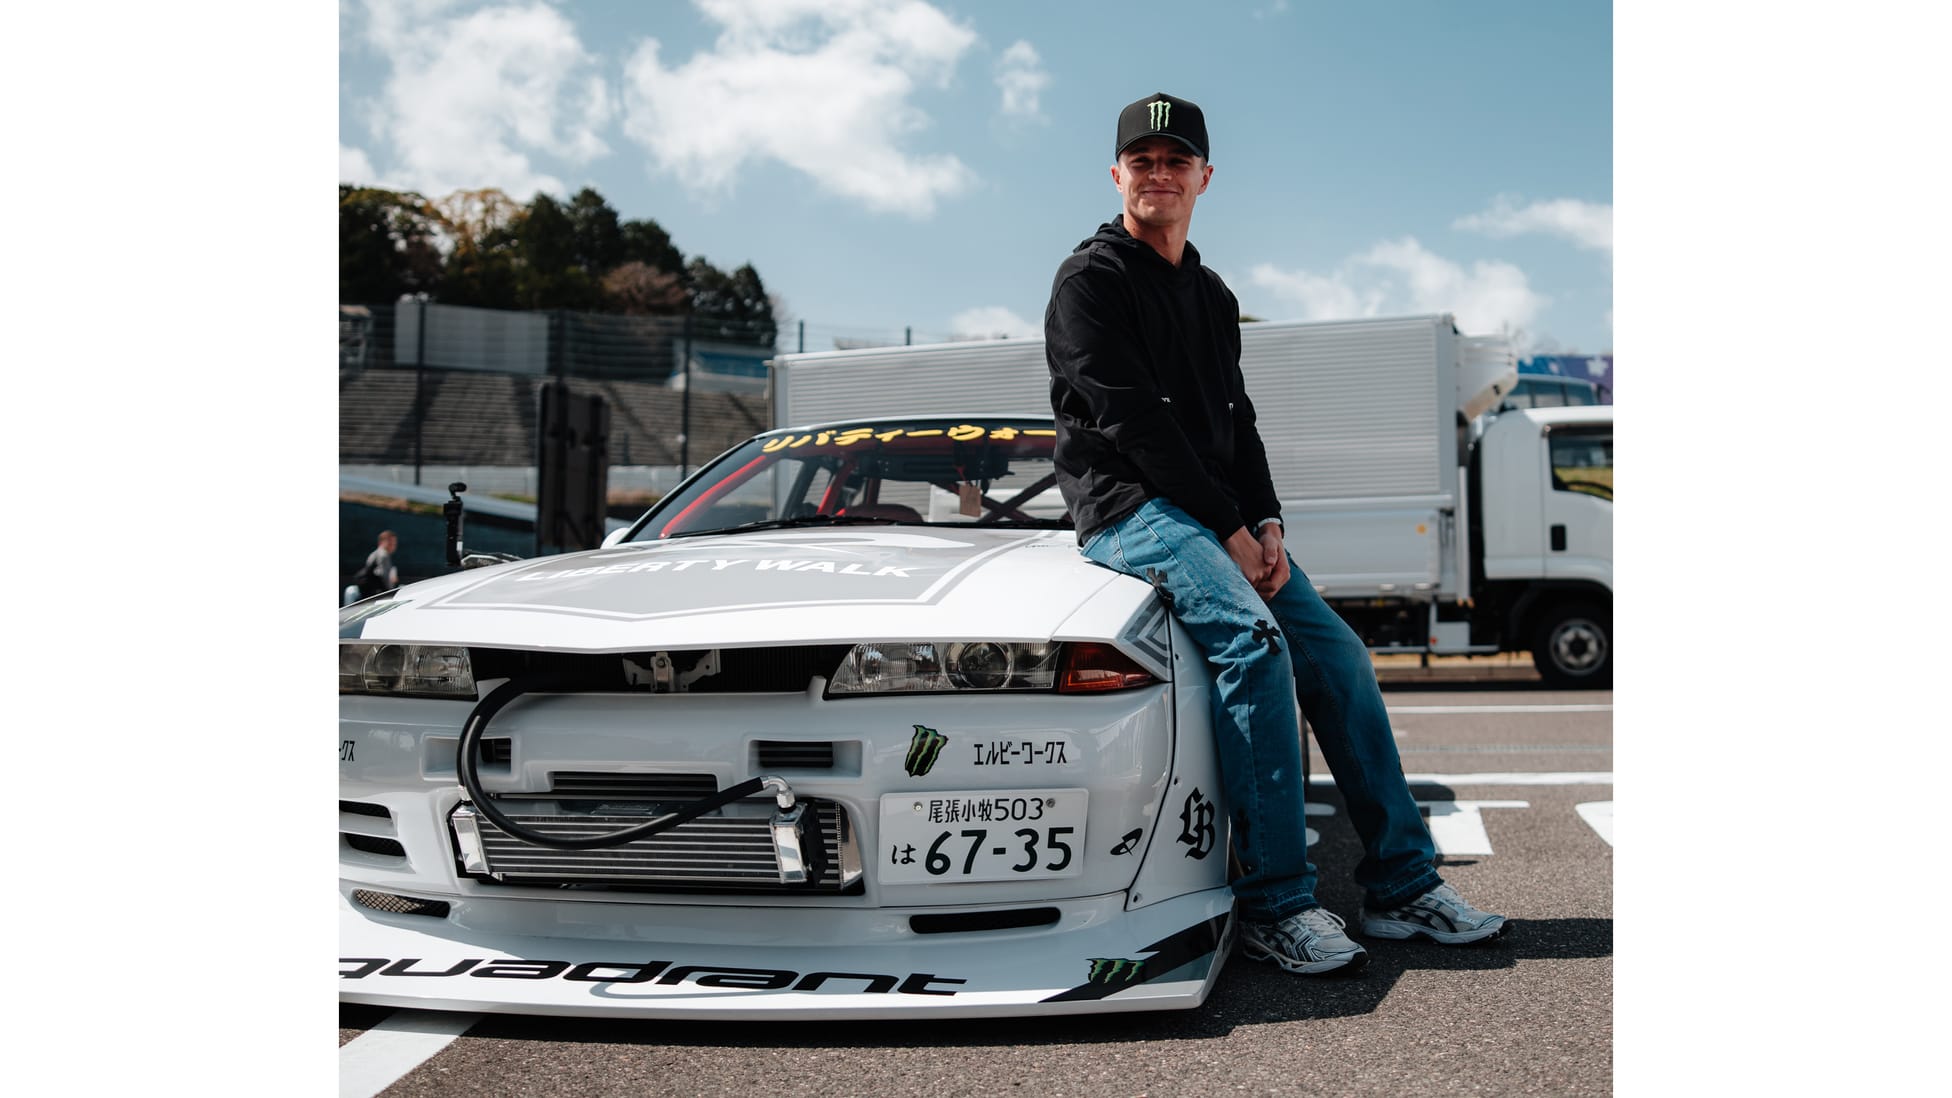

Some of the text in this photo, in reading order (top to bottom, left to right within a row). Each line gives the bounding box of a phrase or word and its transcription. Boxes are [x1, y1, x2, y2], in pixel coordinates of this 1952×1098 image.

[515, 559, 920, 582] LIBERTY WALK
[339, 740, 355, 761] クス
[891, 827, 1074, 875] は 67-35
